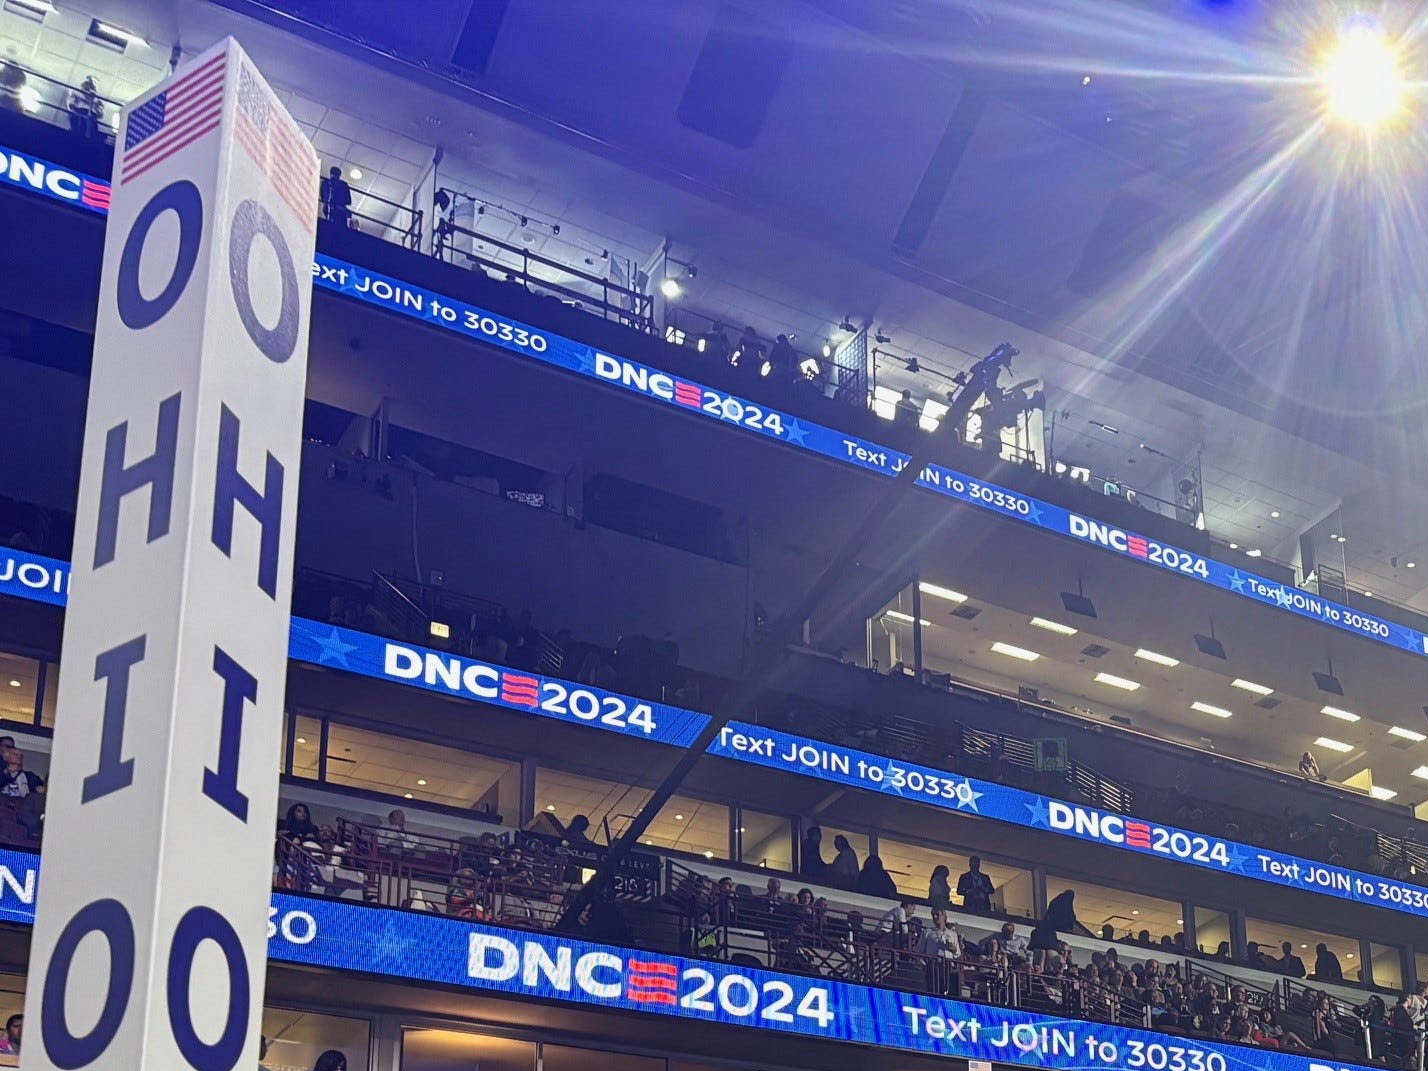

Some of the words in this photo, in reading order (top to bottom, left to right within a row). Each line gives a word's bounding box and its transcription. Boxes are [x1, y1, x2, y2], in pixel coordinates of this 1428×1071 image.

[312, 258, 348, 286] ext
[354, 274, 423, 312] JOIN
[430, 300, 457, 323] to
[463, 309, 547, 353] 30330
[595, 352, 674, 399] DNC
[701, 391, 784, 436] 2024
[843, 440, 887, 467] Text
[891, 457, 940, 486] JIN
[945, 475, 964, 492] to
[969, 483, 1029, 515] 30330
[1069, 514, 1127, 551] DNC
[1148, 546, 1209, 579] 2024
[41, 180, 203, 1070] OHIO
[1248, 578, 1283, 602] Text
[1285, 594, 1321, 615] JOIN
[1325, 606, 1340, 621] to
[1343, 611, 1389, 638] 30330
[385, 644, 498, 698] DNC
[541, 683, 656, 734] 2024
[719, 727, 775, 757] Text
[782, 743, 849, 775] JOIN
[858, 759, 883, 782] to
[891, 766, 973, 803] 30330
[1049, 800, 1124, 843] DNC
[1152, 827, 1230, 867] 2024
[1258, 854, 1299, 880] Text
[1304, 866, 1350, 892] JOIN
[1355, 878, 1374, 896] to
[468, 932, 622, 998] DNC
[680, 968, 834, 1028] 2024
[903, 1005, 981, 1042] Text
[991, 1023, 1075, 1058] JOIN
[1086, 1034, 1117, 1063] to
